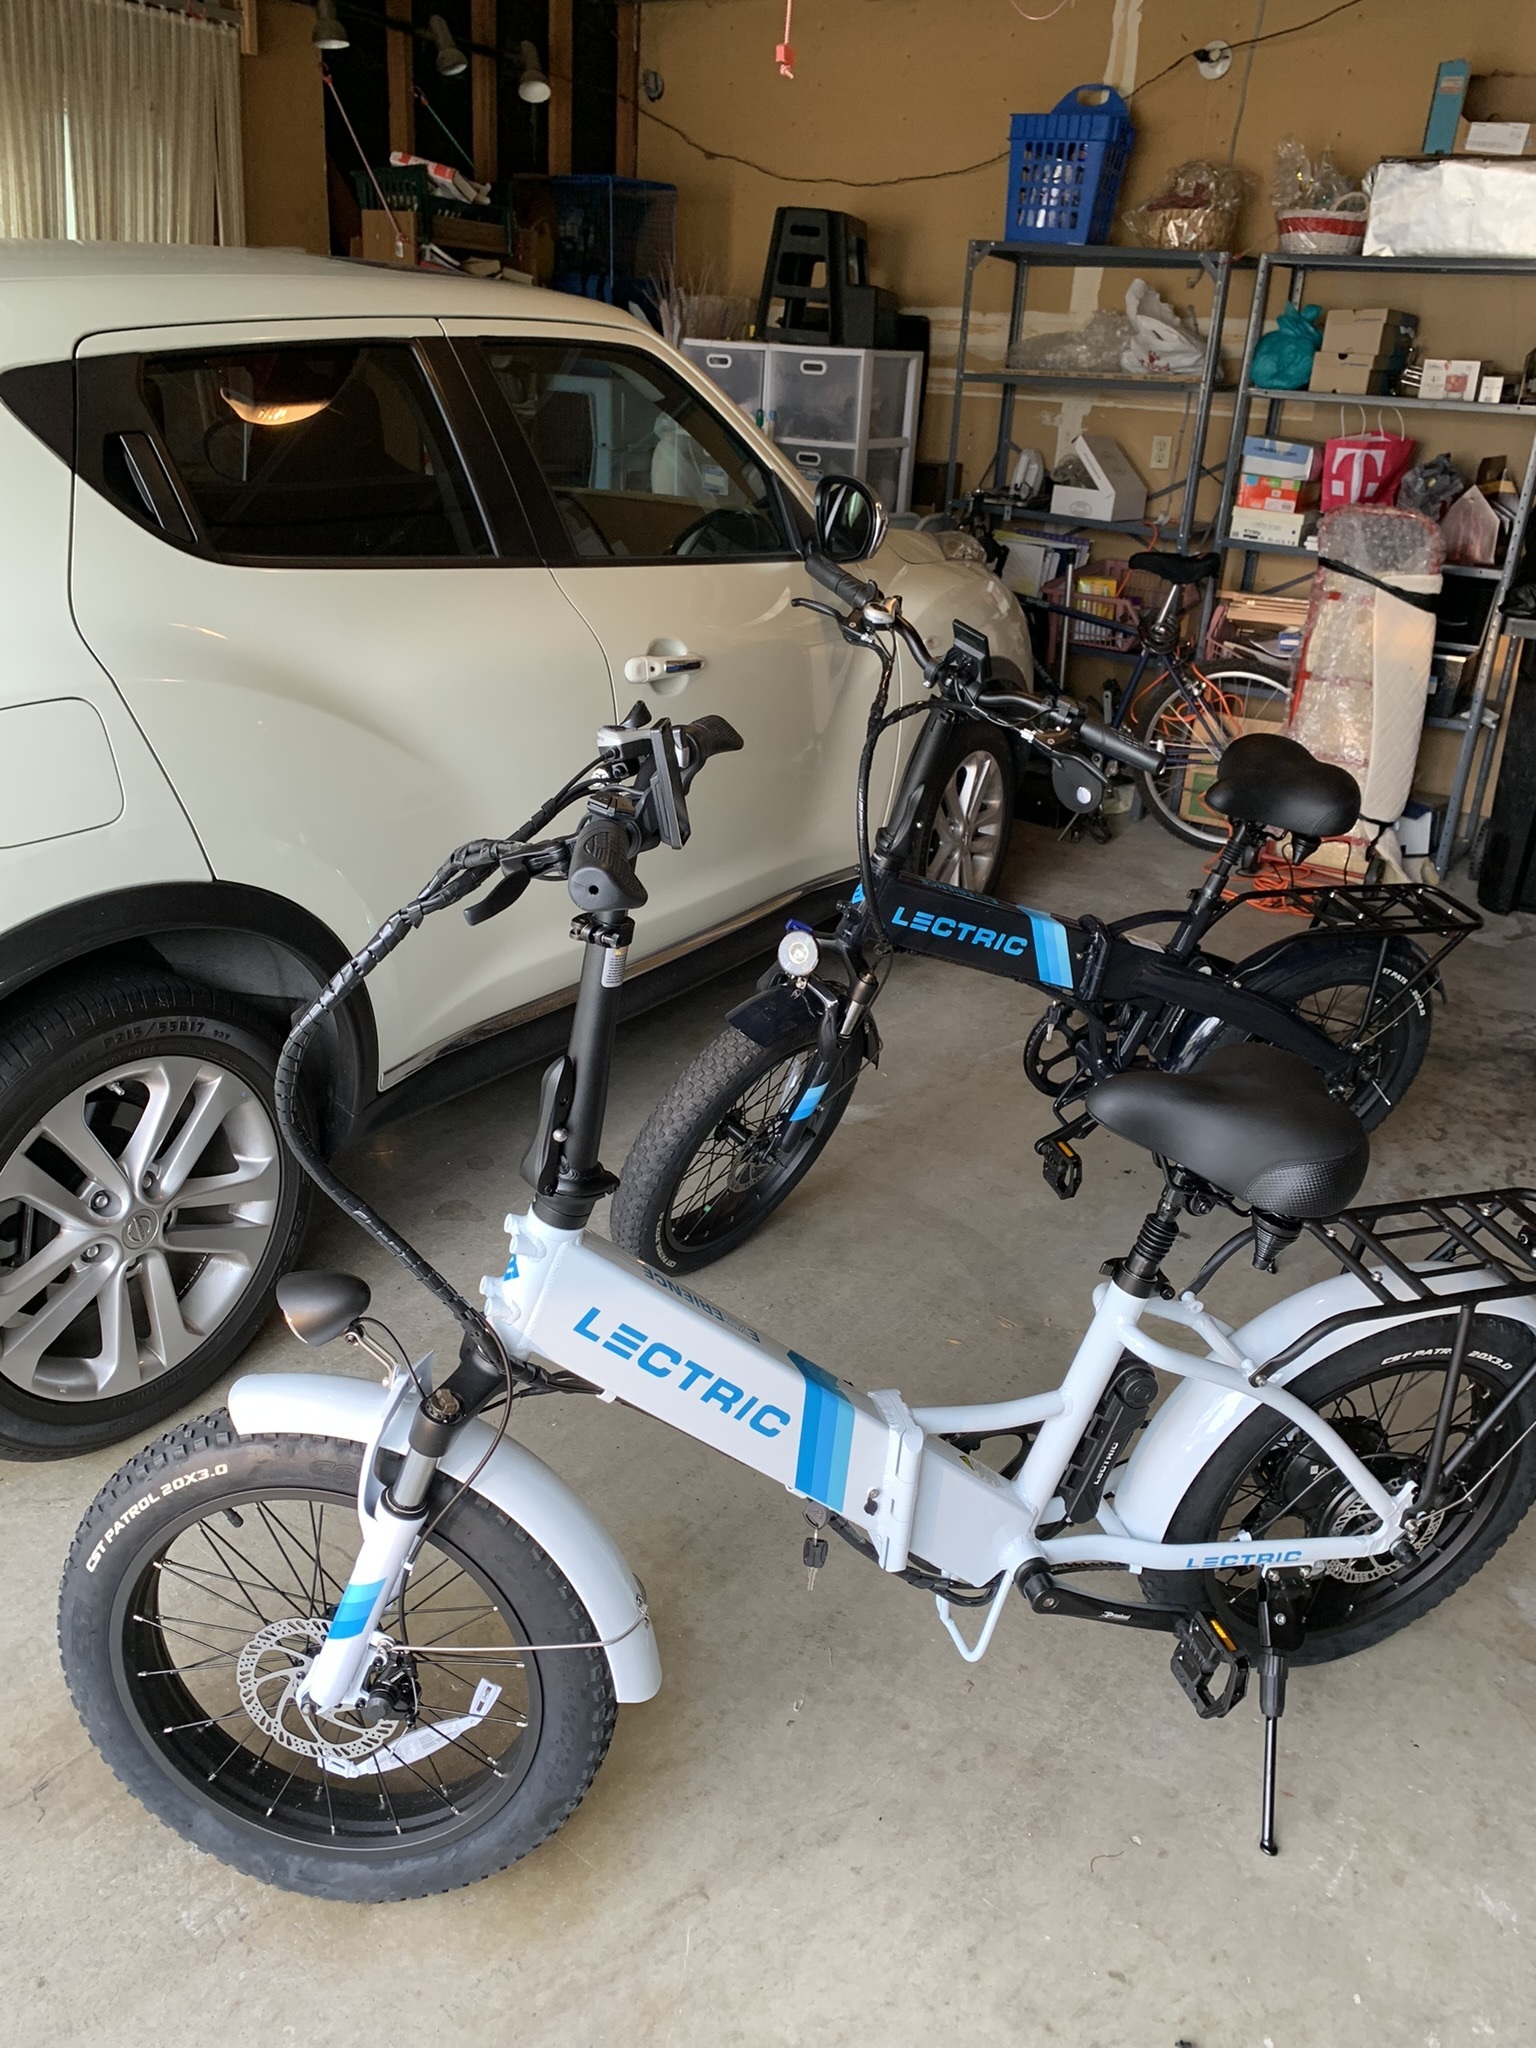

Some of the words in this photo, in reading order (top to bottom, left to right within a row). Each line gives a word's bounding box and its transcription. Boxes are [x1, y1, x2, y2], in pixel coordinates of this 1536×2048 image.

[891, 907, 1028, 956] LECTRIC
[641, 1264, 761, 1343] EERIENCE
[572, 1306, 791, 1438] LECTRIC
[1381, 1352, 1412, 1365] CST
[1412, 1347, 1452, 1358] PATR
[1467, 1350, 1514, 1370] 20X3.0
[309, 1460, 360, 1482] CS
[1093, 1442, 1119, 1485] LECTRIC
[86, 1539, 106, 1573] CST
[104, 1493, 160, 1544] PATROL
[160, 1463, 228, 1497] 20X3.0
[1186, 1550, 1302, 1569] LECTRIC
